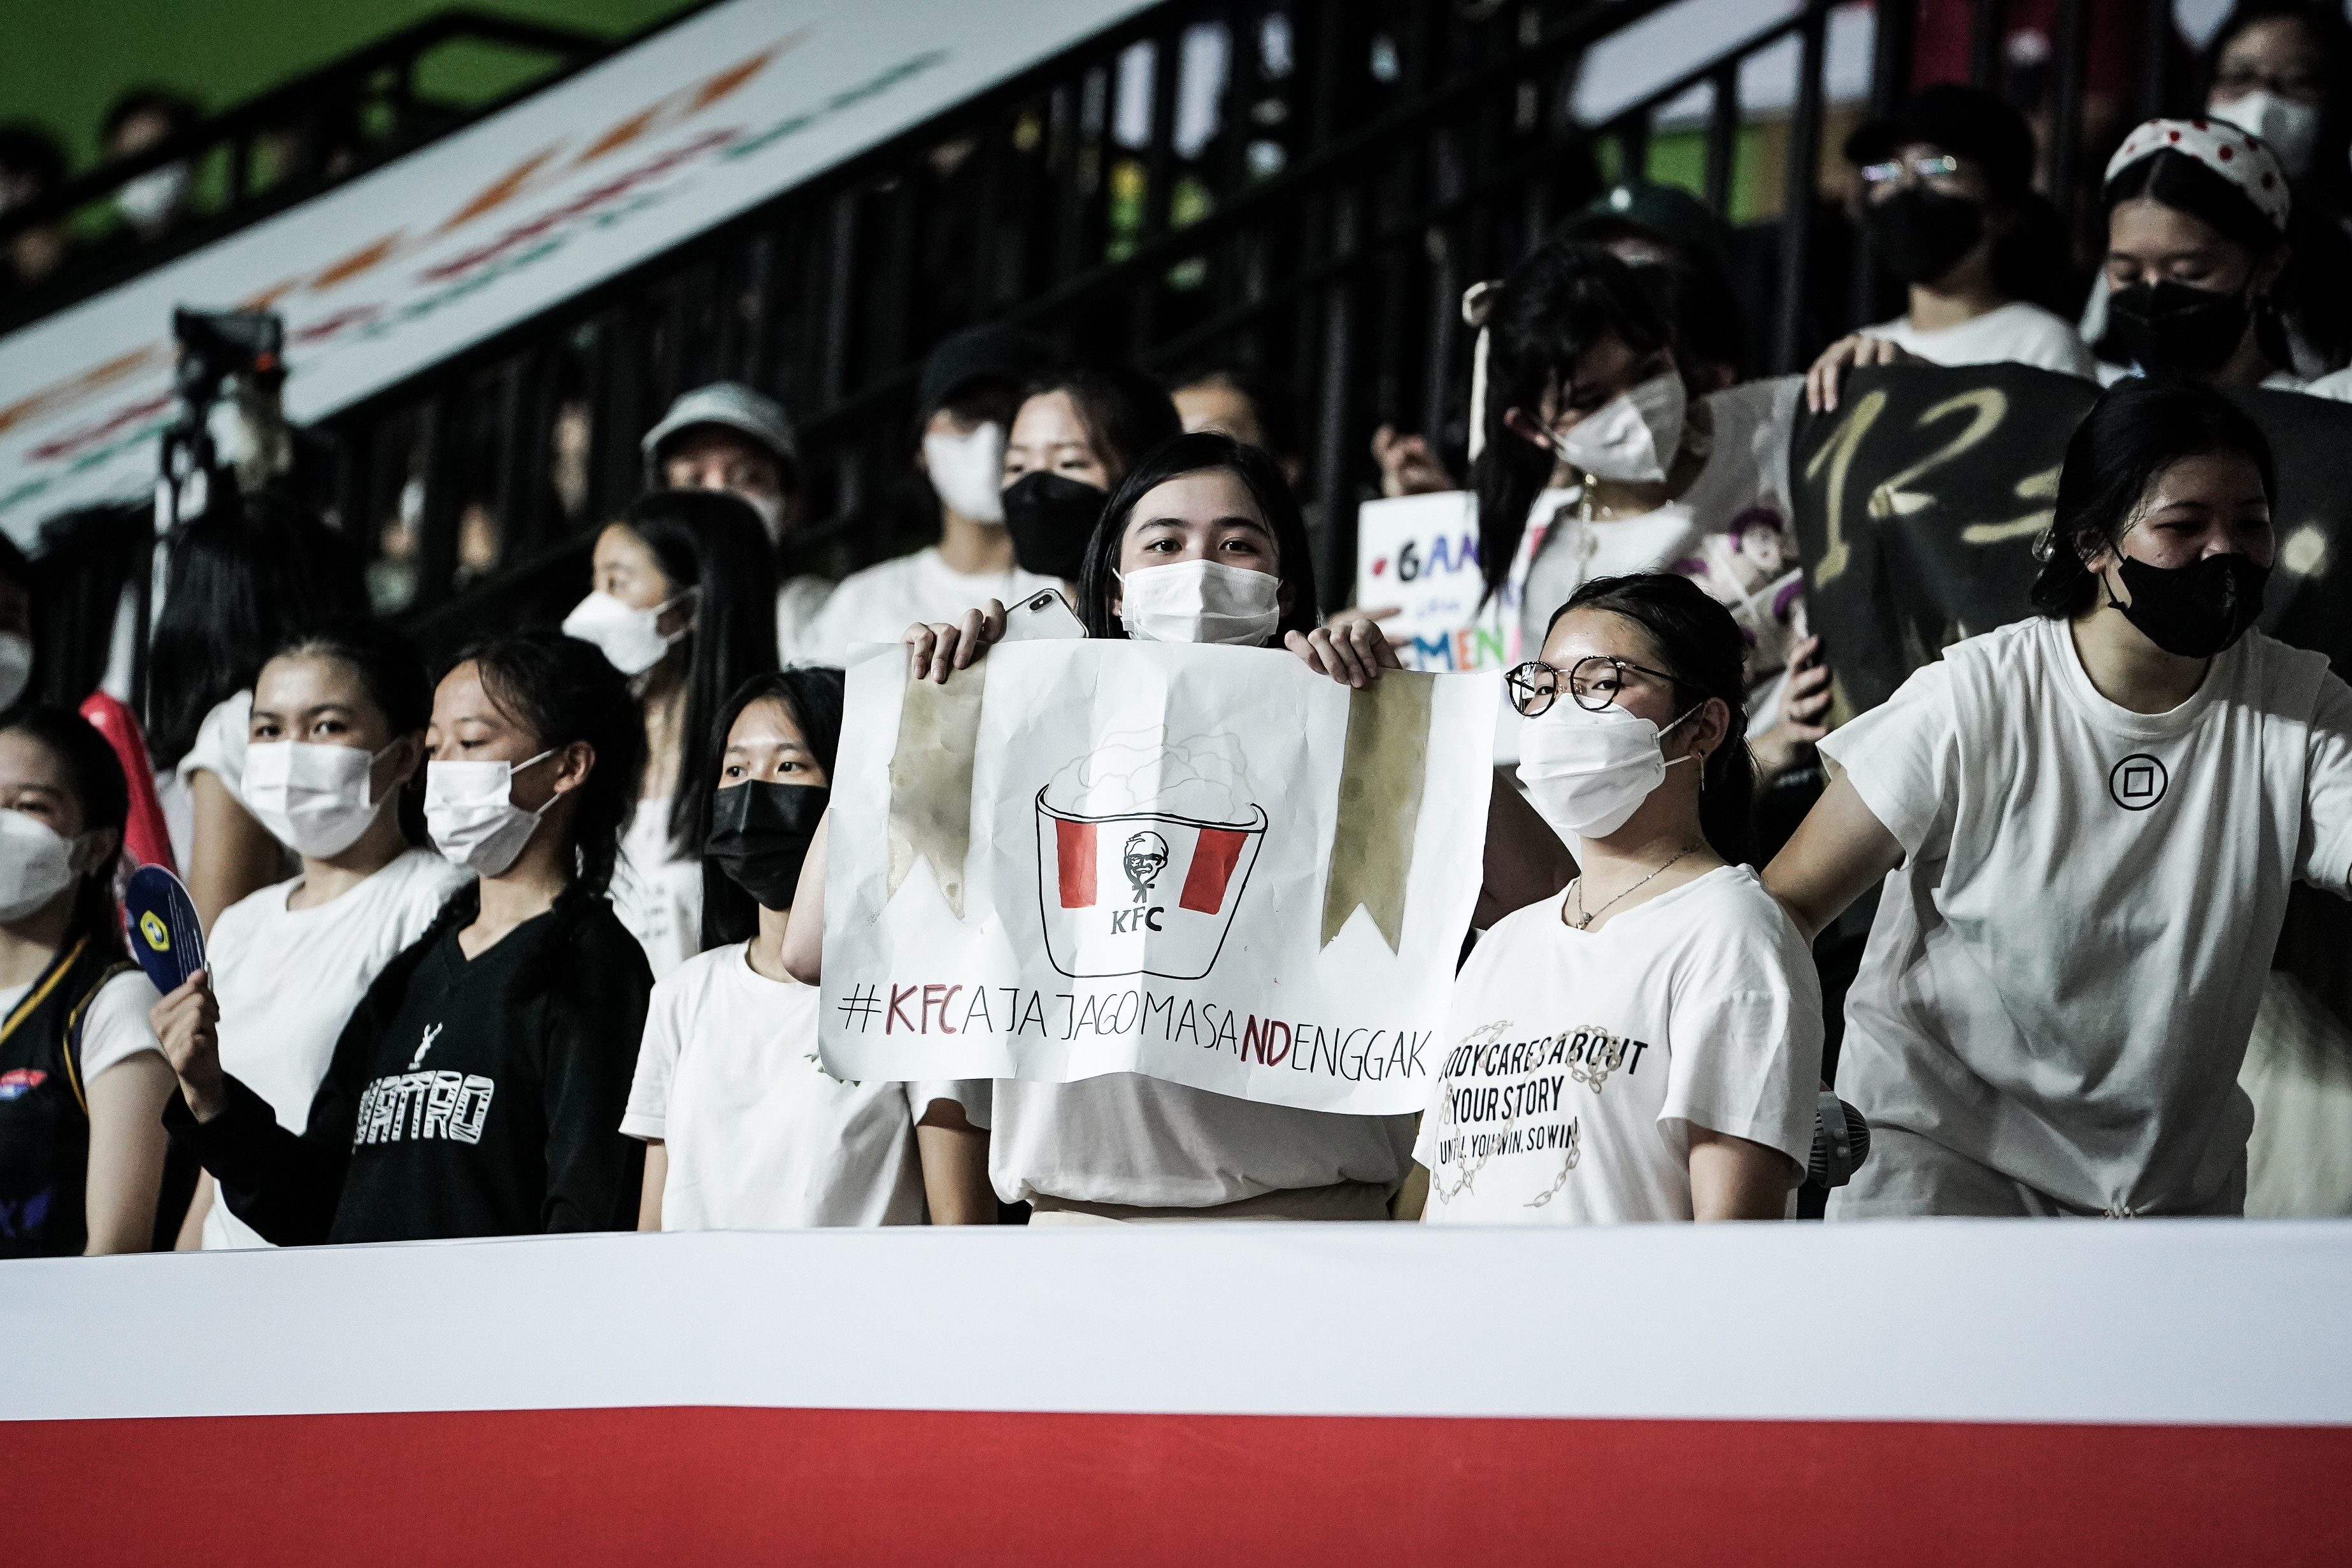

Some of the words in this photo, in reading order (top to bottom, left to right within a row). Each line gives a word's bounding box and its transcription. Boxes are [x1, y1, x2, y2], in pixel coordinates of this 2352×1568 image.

[1111, 906, 1165, 935] KFC
[1485, 1036, 1552, 1078] CARES
[1548, 1032, 1648, 1075] ABOUT
[1452, 1087, 1499, 1125] YOUR
[1501, 1074, 1565, 1120] STORY
[1527, 1126, 1545, 1151] SO
[1546, 1115, 1578, 1150] WIN
